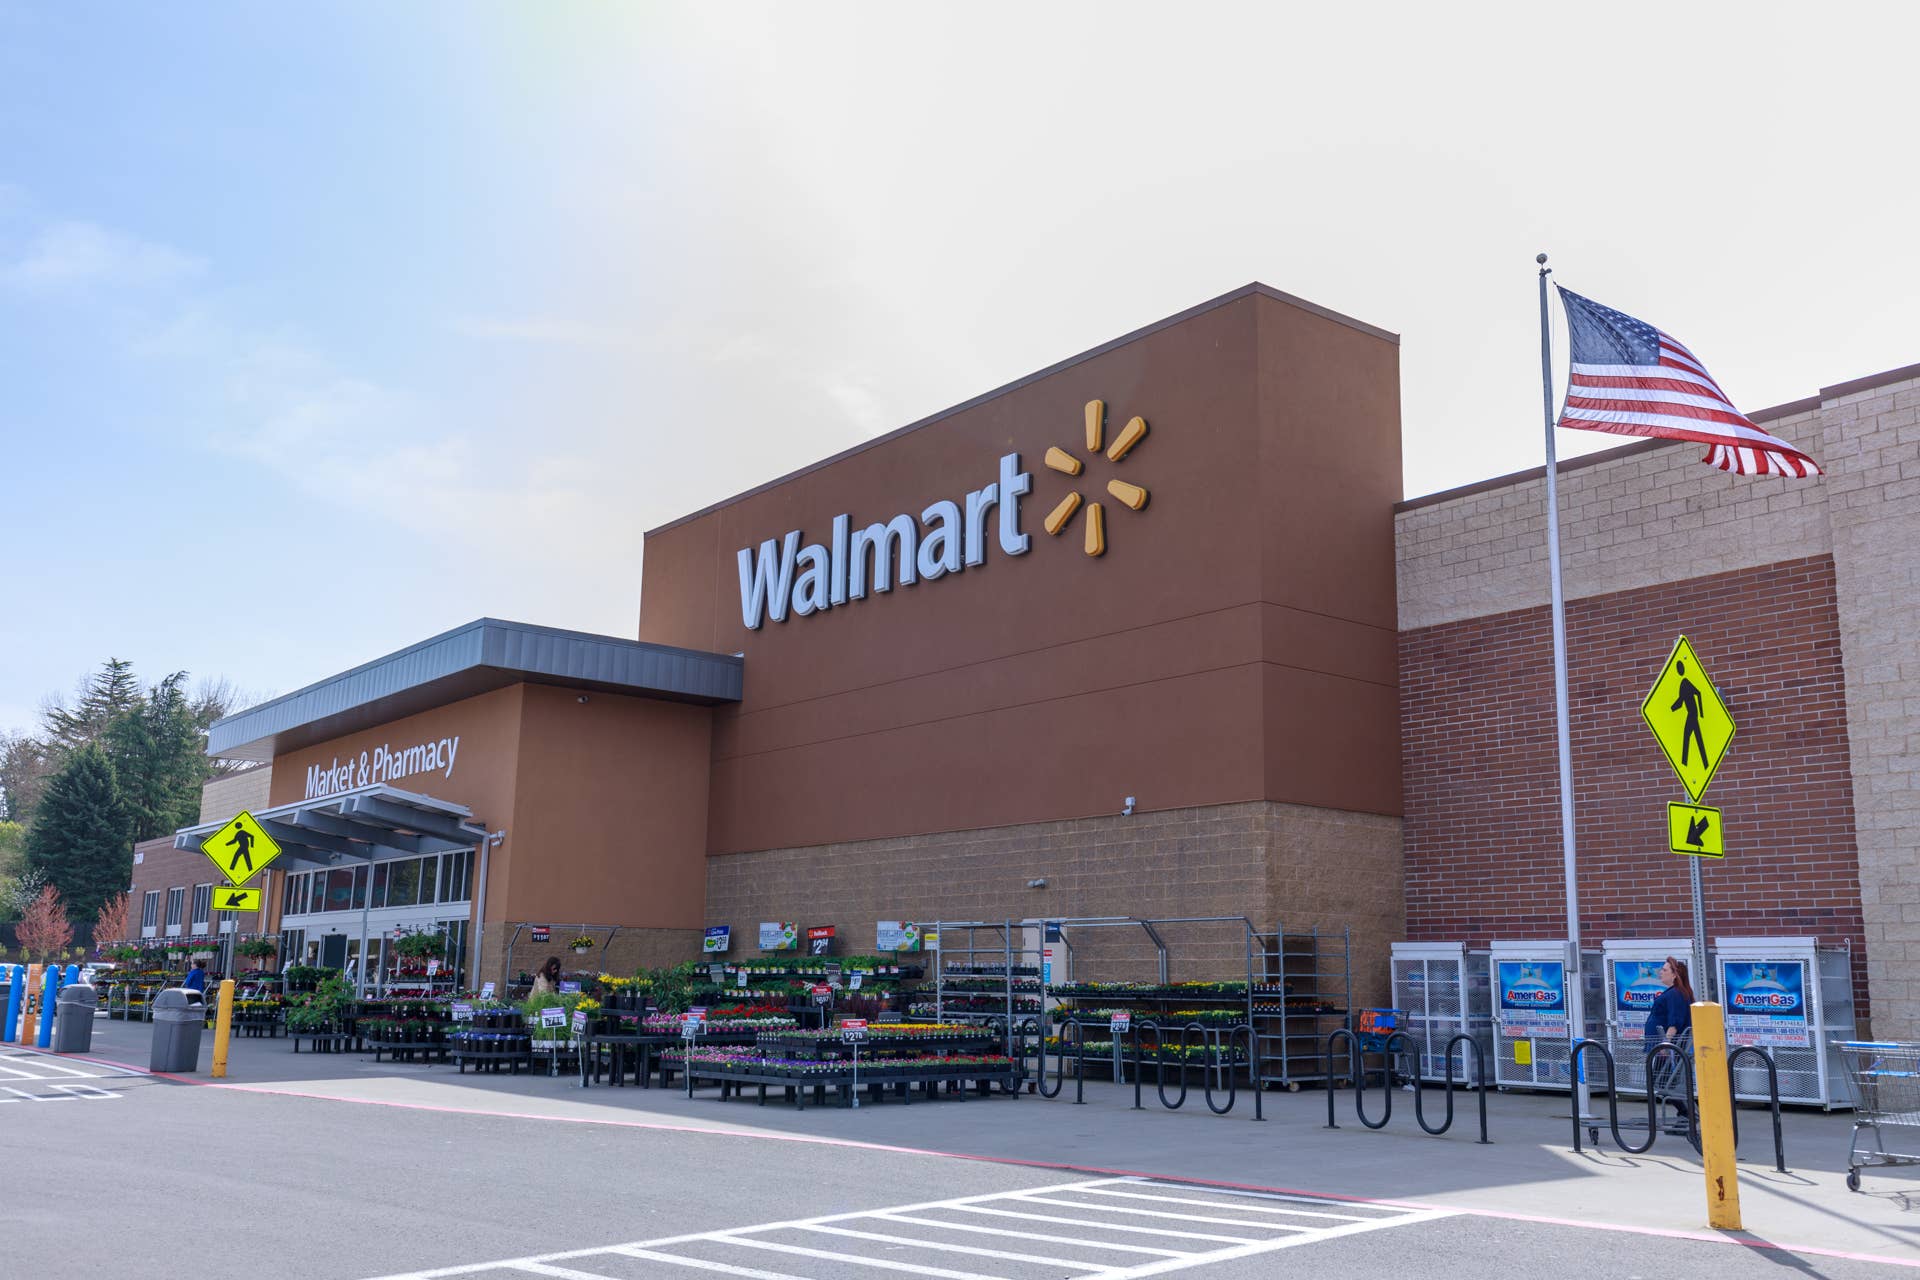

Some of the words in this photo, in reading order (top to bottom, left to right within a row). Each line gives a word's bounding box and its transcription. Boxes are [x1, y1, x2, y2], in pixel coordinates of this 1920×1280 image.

[737, 452, 1031, 630] Walmart
[305, 757, 355, 799] Market
[357, 751, 370, 787] &
[372, 736, 459, 783] Pharmacy
[1507, 990, 1557, 1001] AmeriGas
[1735, 994, 1795, 1005] AmeriGas
